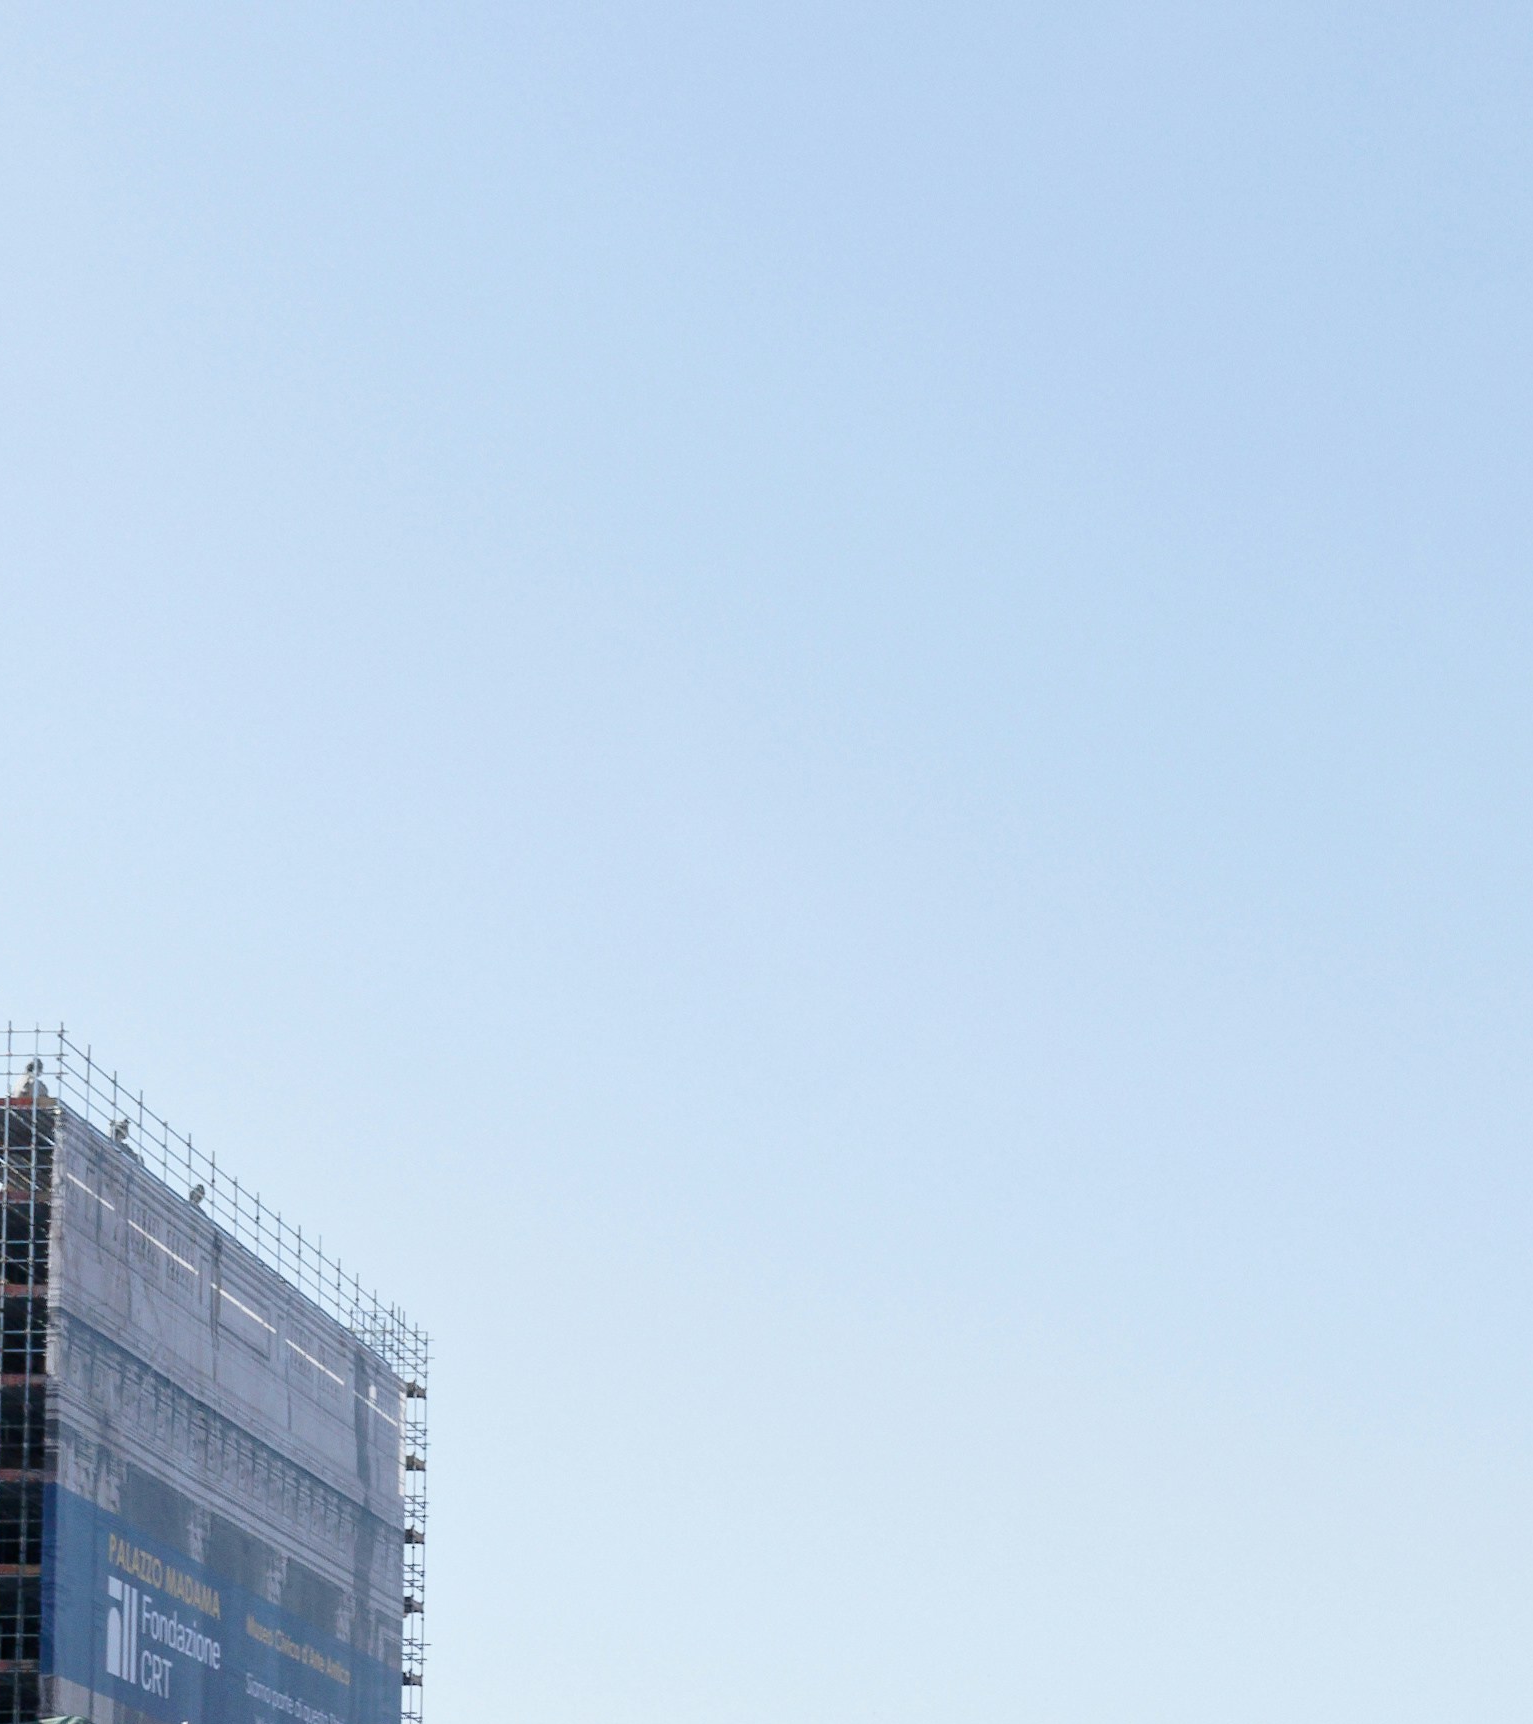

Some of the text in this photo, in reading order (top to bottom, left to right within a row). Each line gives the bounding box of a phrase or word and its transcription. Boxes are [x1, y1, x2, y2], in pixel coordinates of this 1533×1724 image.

[109, 1533, 221, 1620] PALAZZO MADAMA
[142, 1594, 221, 1671] Fondazione
[140, 1650, 173, 1699] CRT
